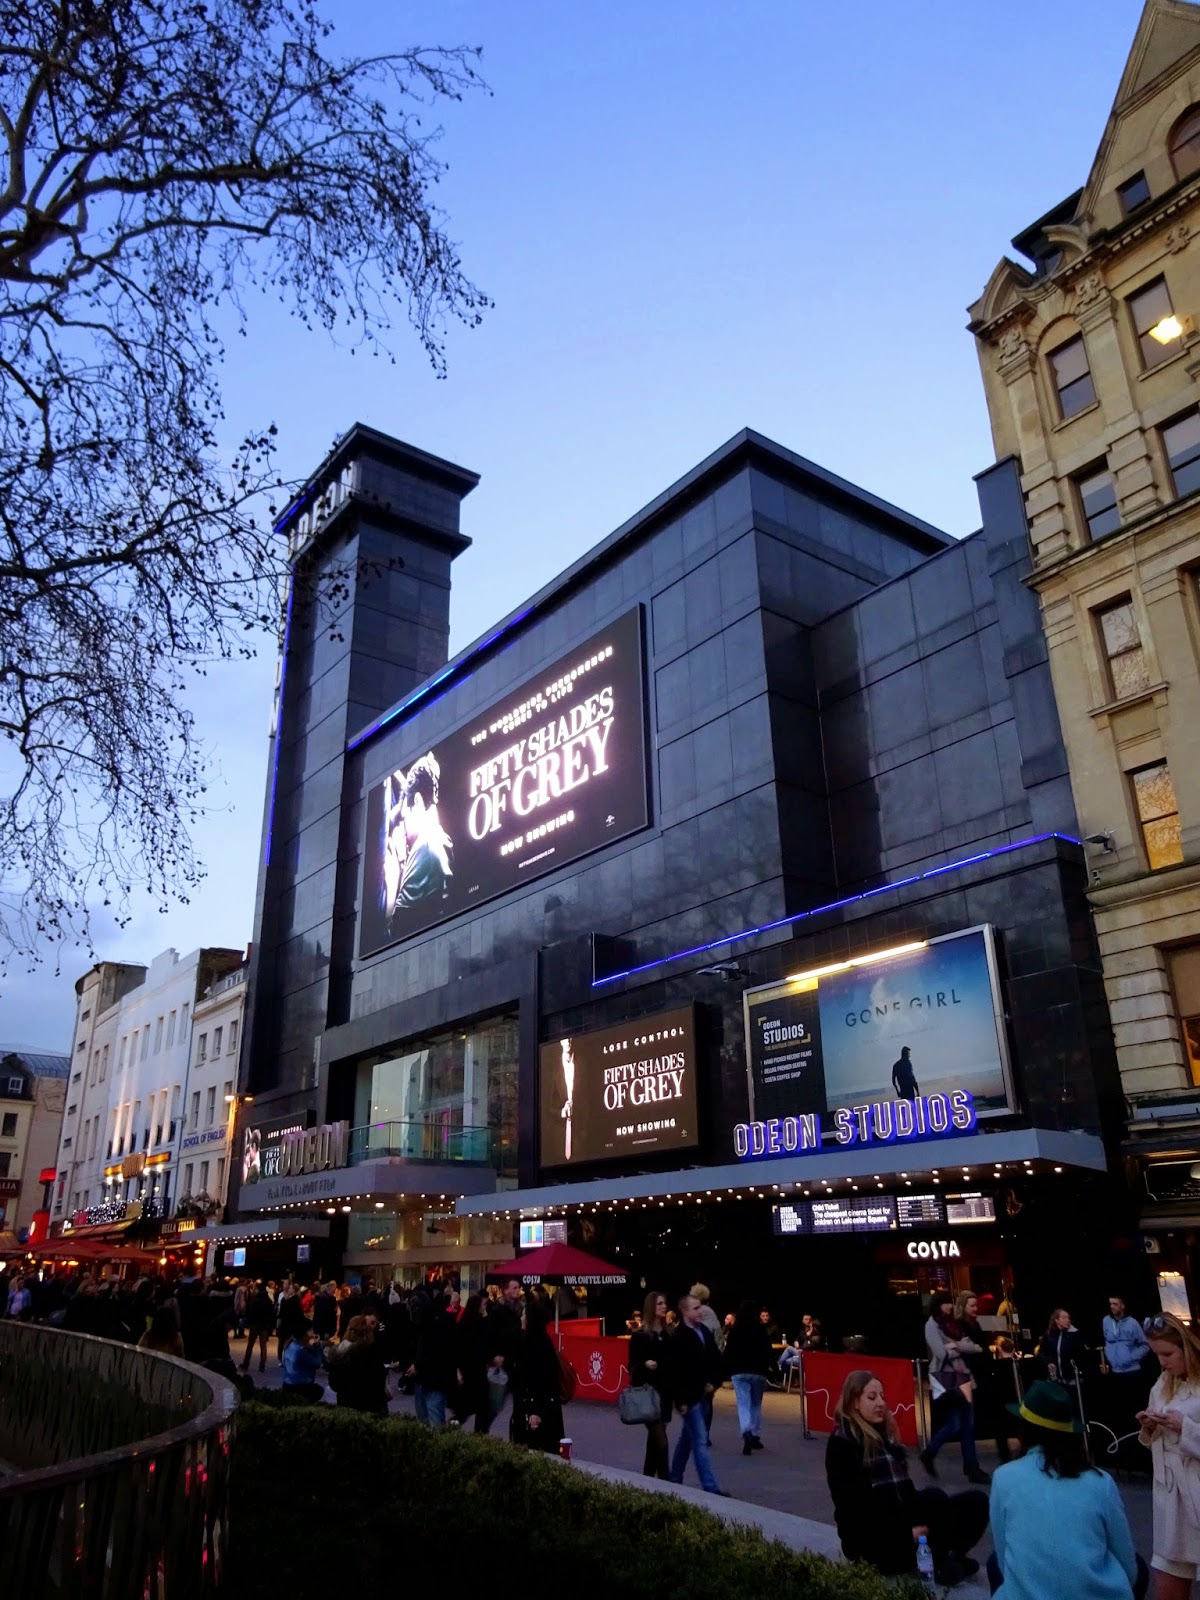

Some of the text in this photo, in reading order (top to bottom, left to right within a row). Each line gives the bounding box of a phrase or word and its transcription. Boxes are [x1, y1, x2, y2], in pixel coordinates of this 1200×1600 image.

[471, 645, 613, 746] THE WORLDWIDE PHENOMENON
[502, 681, 573, 734] COMES TO LIFE
[470, 686, 614, 798] FIFTY SHADES
[468, 717, 614, 840] OF GREY
[500, 809, 575, 856] NOW SHOWING
[845, 988, 961, 1027] GONE GIRL
[762, 1019, 781, 1030] ODEON
[763, 1023, 804, 1045] STUDIOS
[603, 1027, 684, 1054] LOSE CONTROL
[604, 1052, 685, 1085] FIFTY SHADES
[776, 1073, 790, 1081] COFFEE
[603, 1069, 685, 1110] OF GREY
[616, 1118, 676, 1136] NOW SHOWING
[733, 1090, 973, 1158] ODEON STUDIOS
[183, 1129, 226, 1149] SCHOOL OF ENGLISH
[281, 1120, 350, 1178] ODEON
[0, 1182, 16, 1191] LIA
[814, 1211, 823, 1219] The
[824, 1210, 848, 1220] cheapest
[848, 1208, 867, 1217] cinema
[867, 1207, 882, 1216] ticket
[883, 1207, 891, 1215] for
[825, 1203, 839, 1211] Ticket
[161, 1220, 195, 1234] BELLA ITALIA
[814, 1214, 888, 1226] children on Leicester Square
[907, 1240, 961, 1260] COSTA
[522, 1275, 627, 1285] COSTA FOR COFFEE LOVERS
